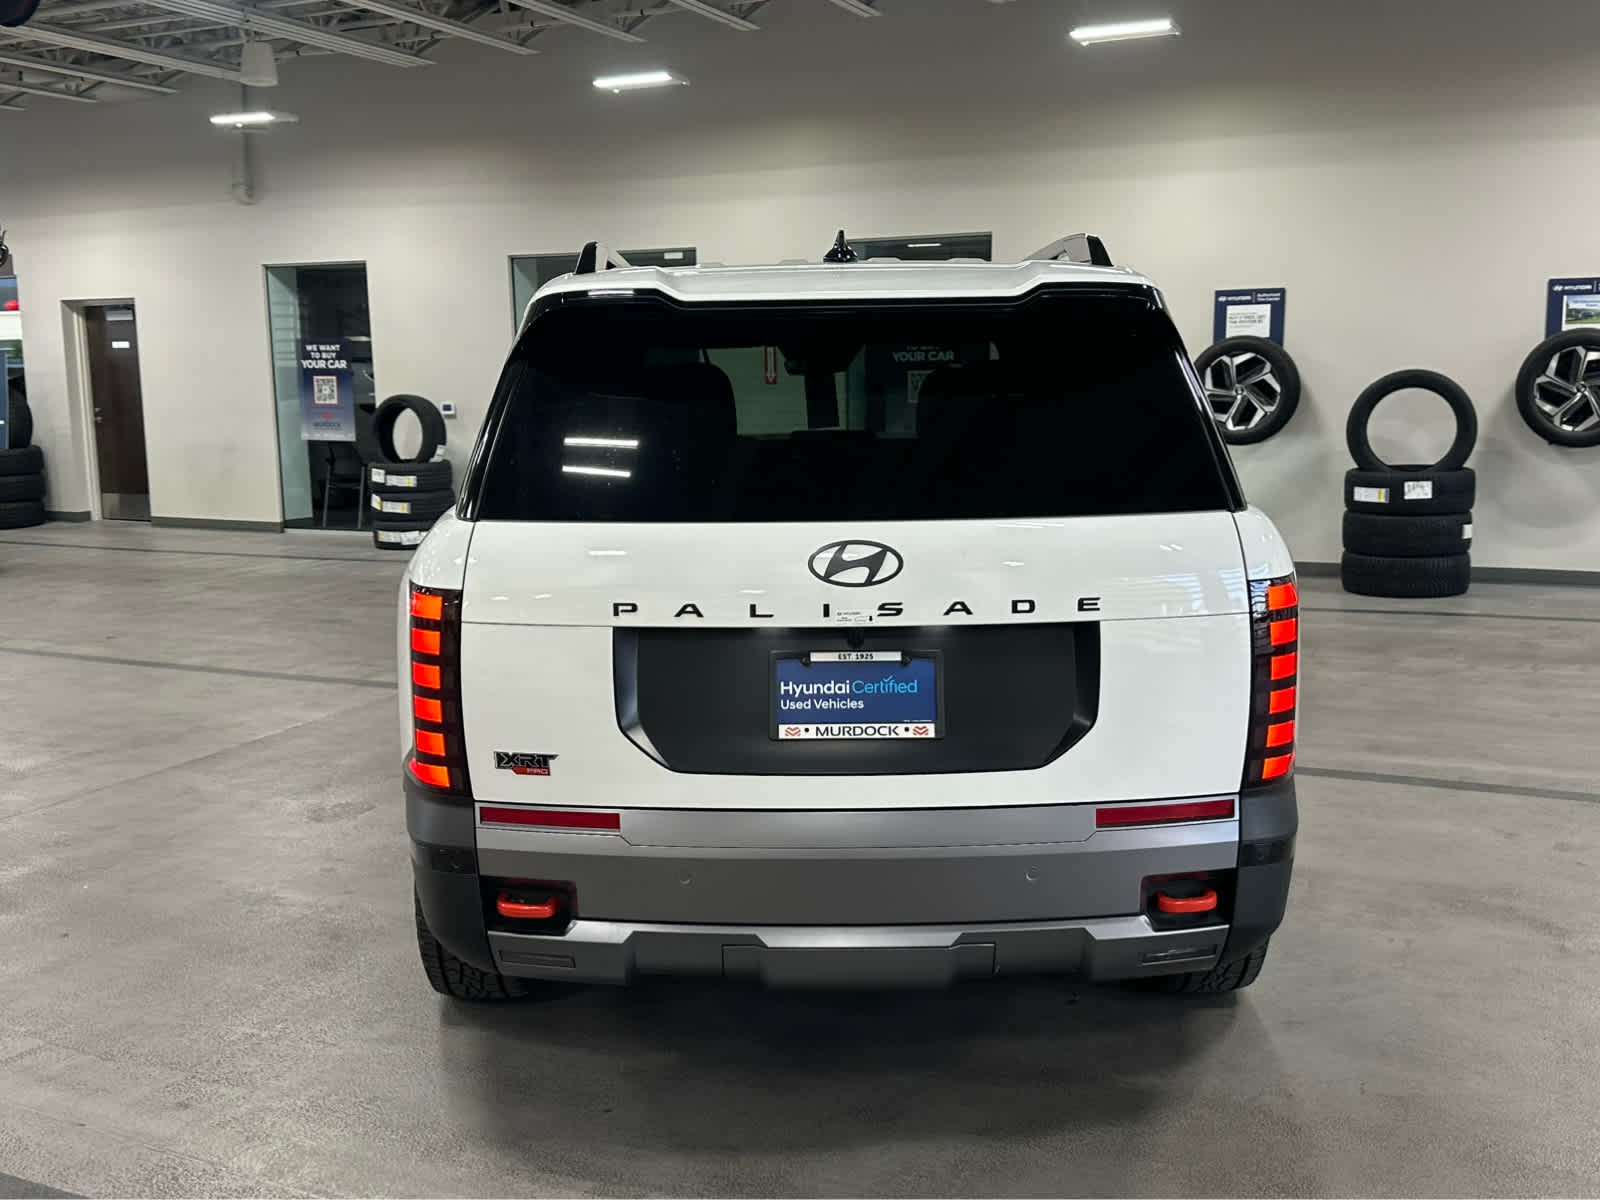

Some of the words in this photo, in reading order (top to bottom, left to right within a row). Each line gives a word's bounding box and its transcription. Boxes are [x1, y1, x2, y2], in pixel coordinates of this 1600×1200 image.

[305, 344, 318, 352] WE
[319, 344, 341, 352] WANT
[892, 351, 926, 362] YOUR
[927, 350, 955, 362] CAR
[301, 359, 327, 369] YOUR
[327, 359, 348, 369] CAR
[612, 597, 1102, 618] PALISADE
[780, 680, 850, 698] Hyundai
[852, 675, 918, 694] Certified
[780, 699, 812, 710] Used
[814, 698, 865, 710] Vehicles
[815, 725, 900, 737] MURDOCK
